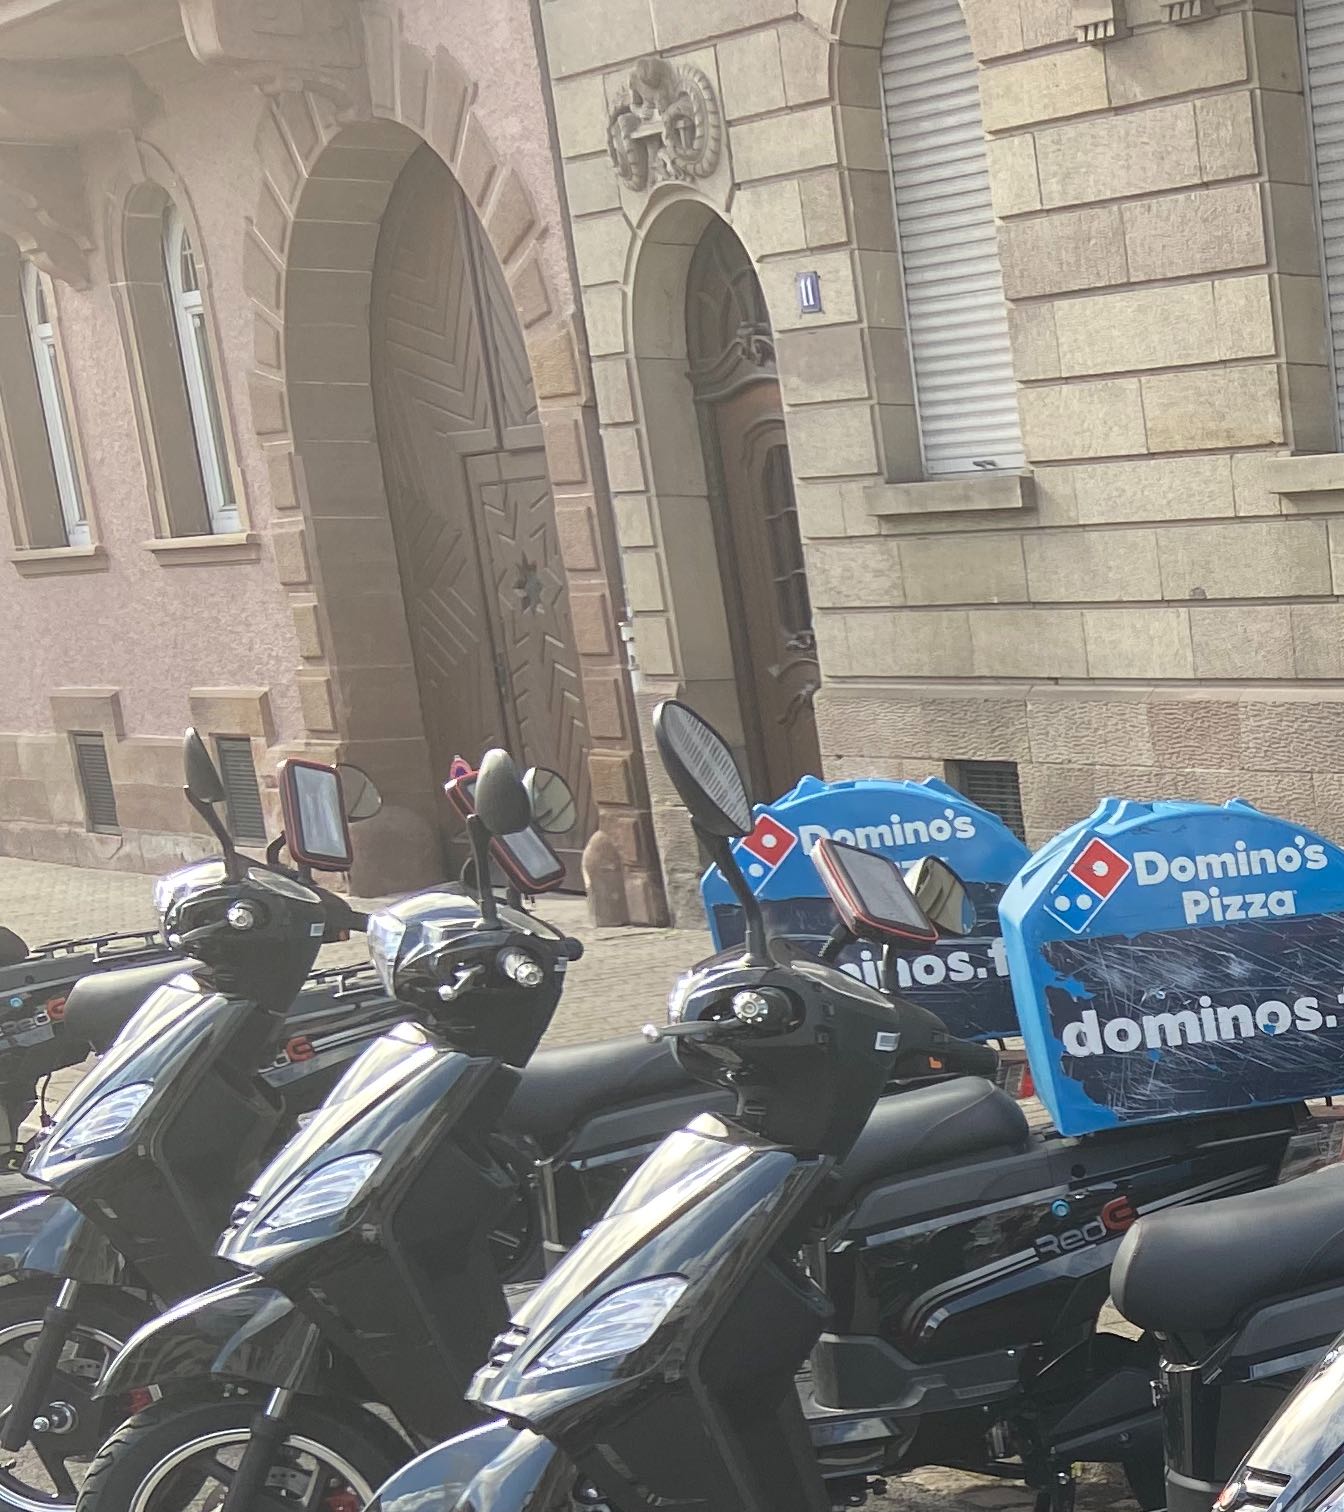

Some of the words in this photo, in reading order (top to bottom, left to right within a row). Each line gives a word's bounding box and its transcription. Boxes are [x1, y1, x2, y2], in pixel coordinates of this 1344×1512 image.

[799, 276, 815, 306] 11
[798, 808, 976, 856] Domino's
[1132, 836, 1329, 887] Domino's
[1181, 888, 1297, 925] Pizza
